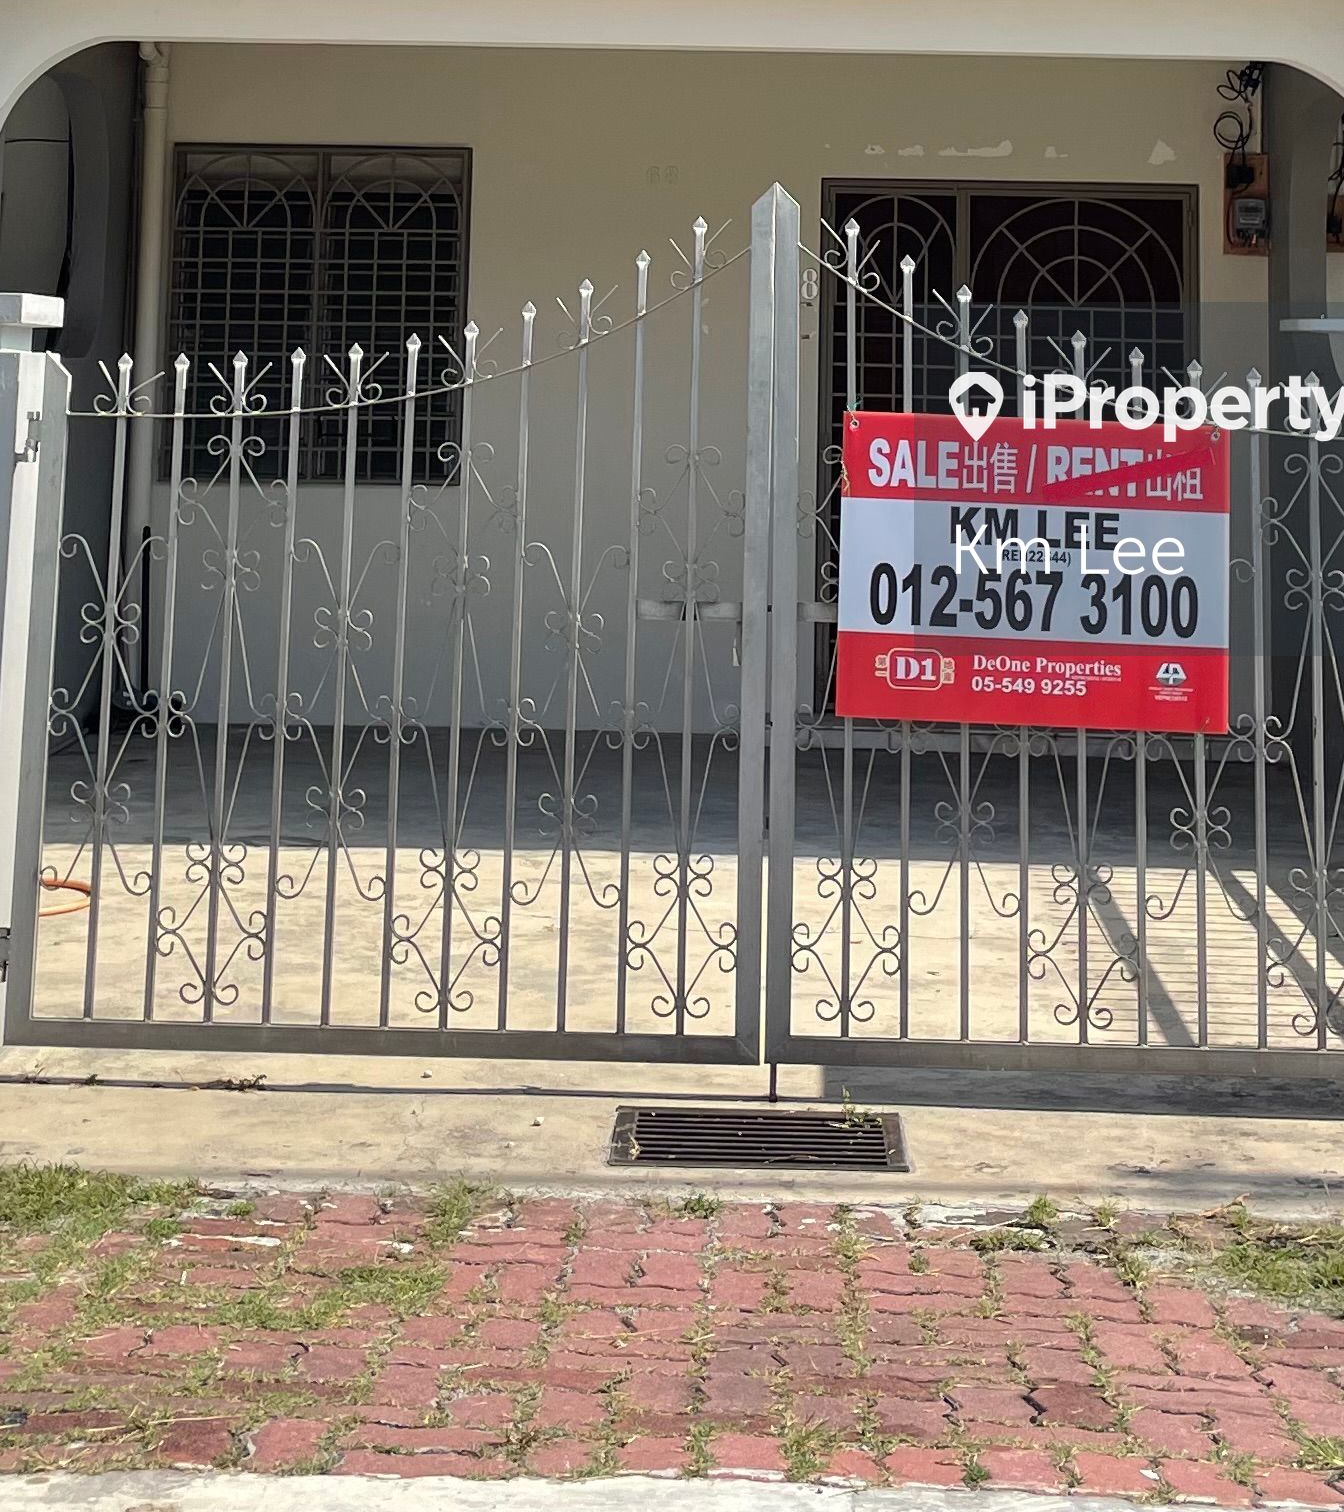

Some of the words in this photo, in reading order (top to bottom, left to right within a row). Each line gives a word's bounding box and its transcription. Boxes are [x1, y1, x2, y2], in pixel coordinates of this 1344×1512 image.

[949, 506, 1019, 546] KM
[1037, 510, 1120, 551] LEE
[869, 562, 1064, 632] 012-567
[1079, 573, 1199, 639] 3100
[972, 654, 1031, 672] DeOne
[1035, 657, 1122, 678] Properties
[971, 676, 1036, 694] 05-549
[1040, 678, 1087, 697] 9255
